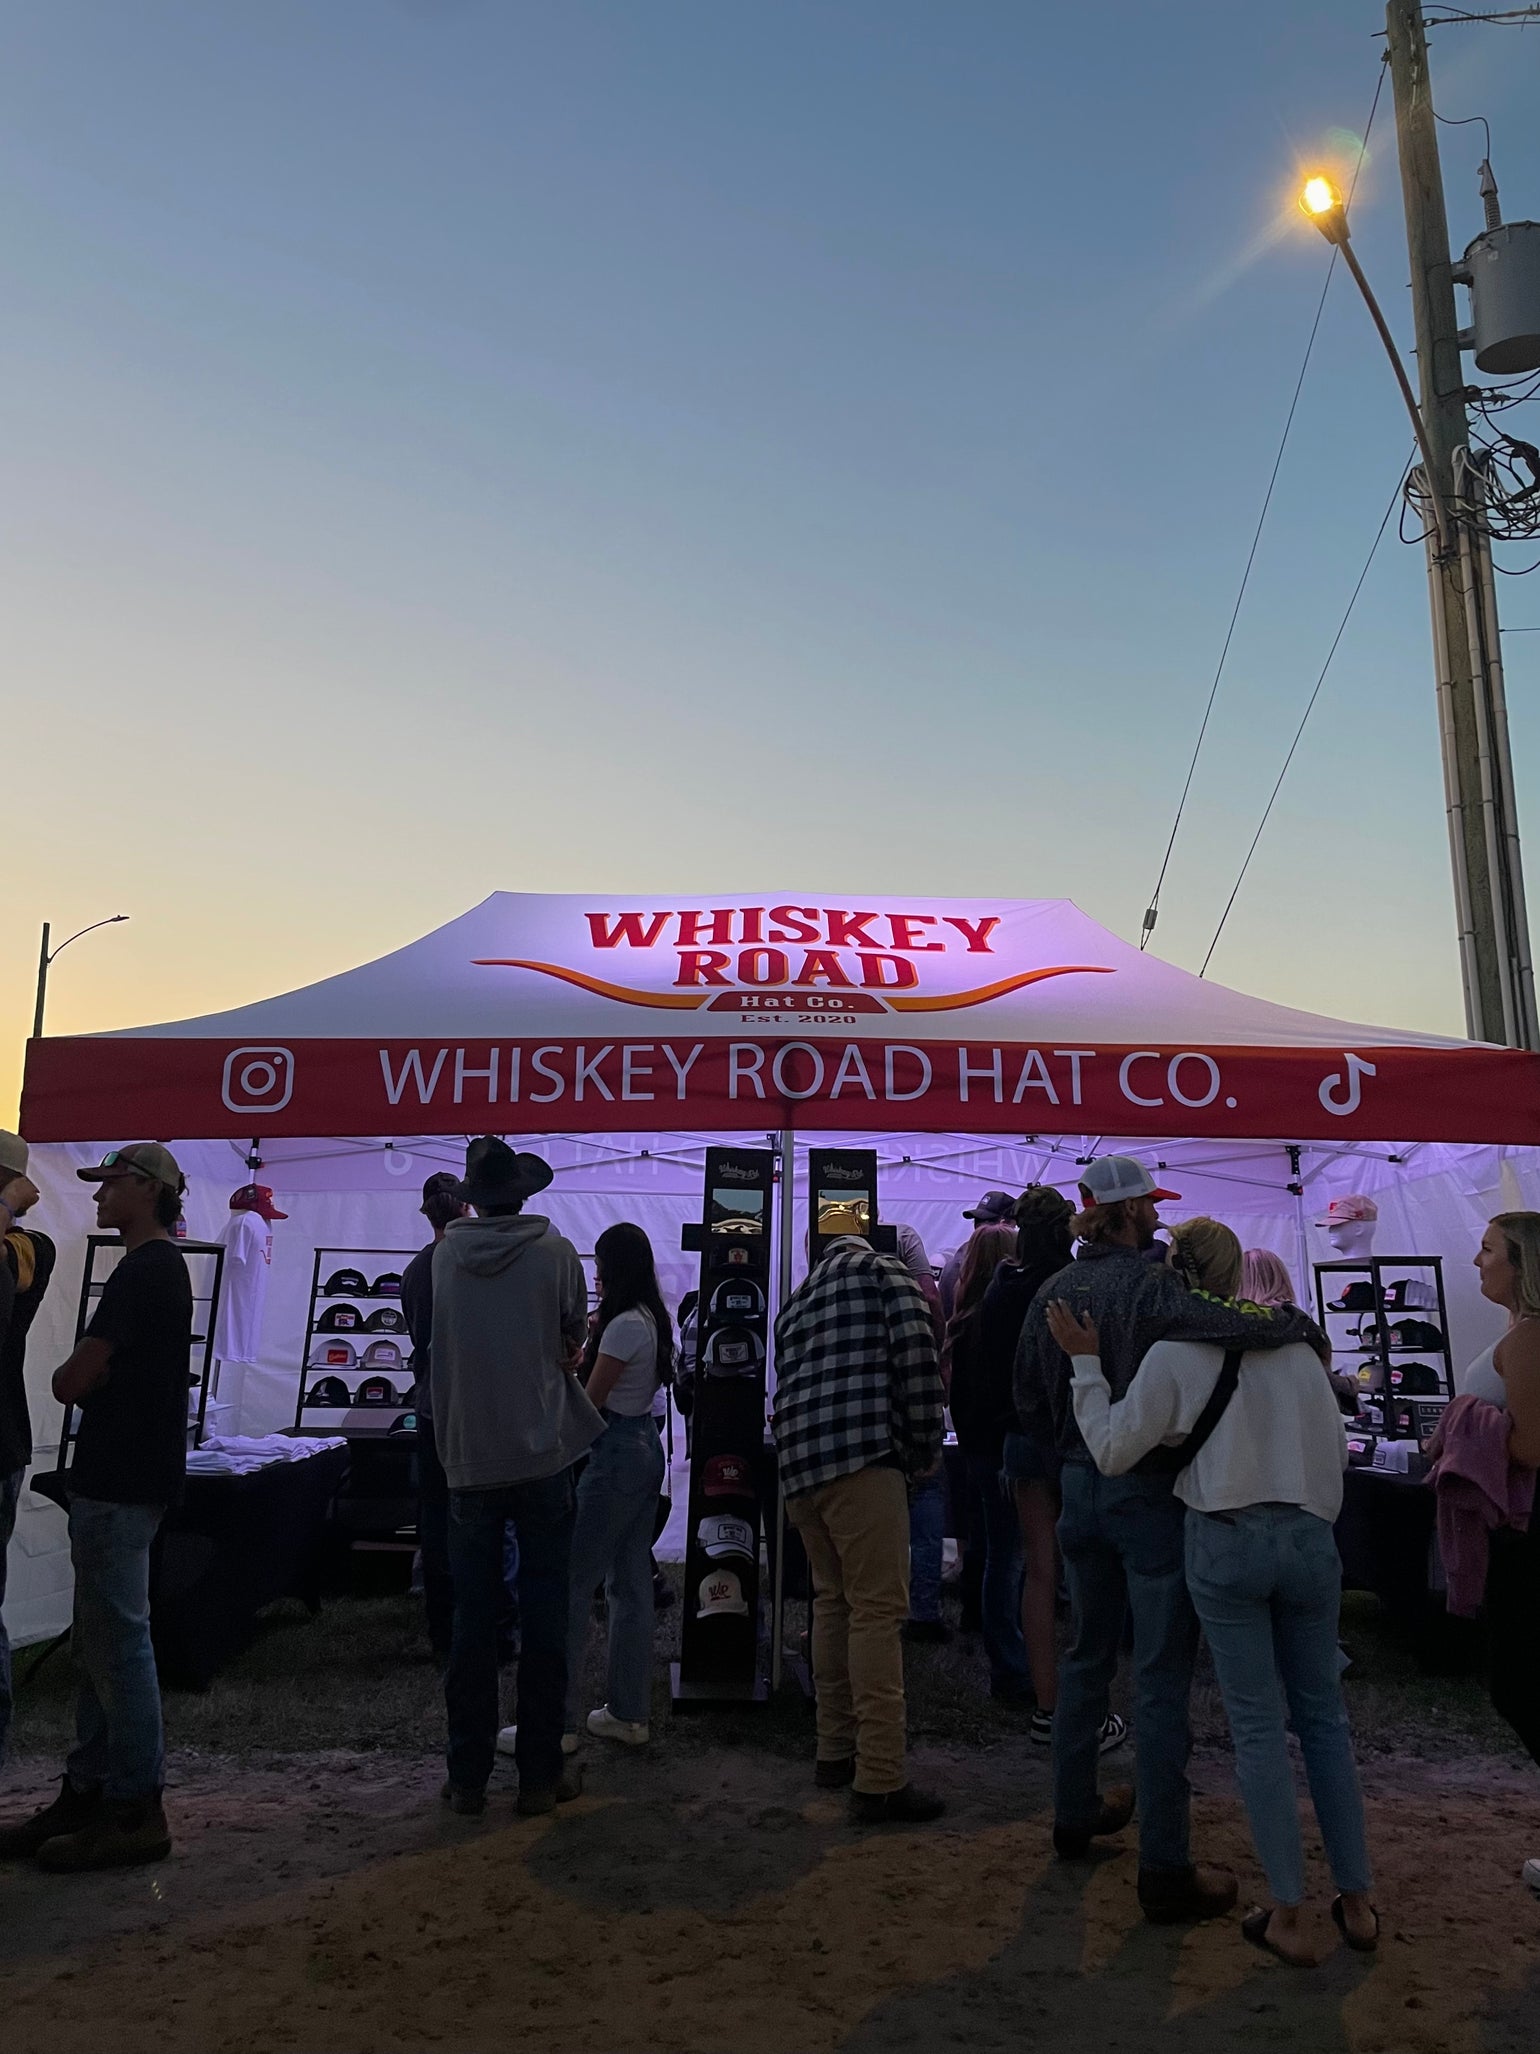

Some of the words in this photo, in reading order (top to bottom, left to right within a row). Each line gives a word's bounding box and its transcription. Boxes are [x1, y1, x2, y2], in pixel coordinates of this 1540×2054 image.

[584, 905, 1001, 954] WHISKEY
[672, 947, 920, 990] ROAD
[740, 996, 795, 1007] Hat
[806, 996, 854, 1009] Co.
[741, 1014, 790, 1023] Est.
[798, 1015, 857, 1024] 2020
[379, 1043, 704, 1104] WHISKEY
[729, 1042, 933, 1101] ROAD
[958, 1047, 1096, 1105] HAT
[1118, 1051, 1238, 1108] CO.
